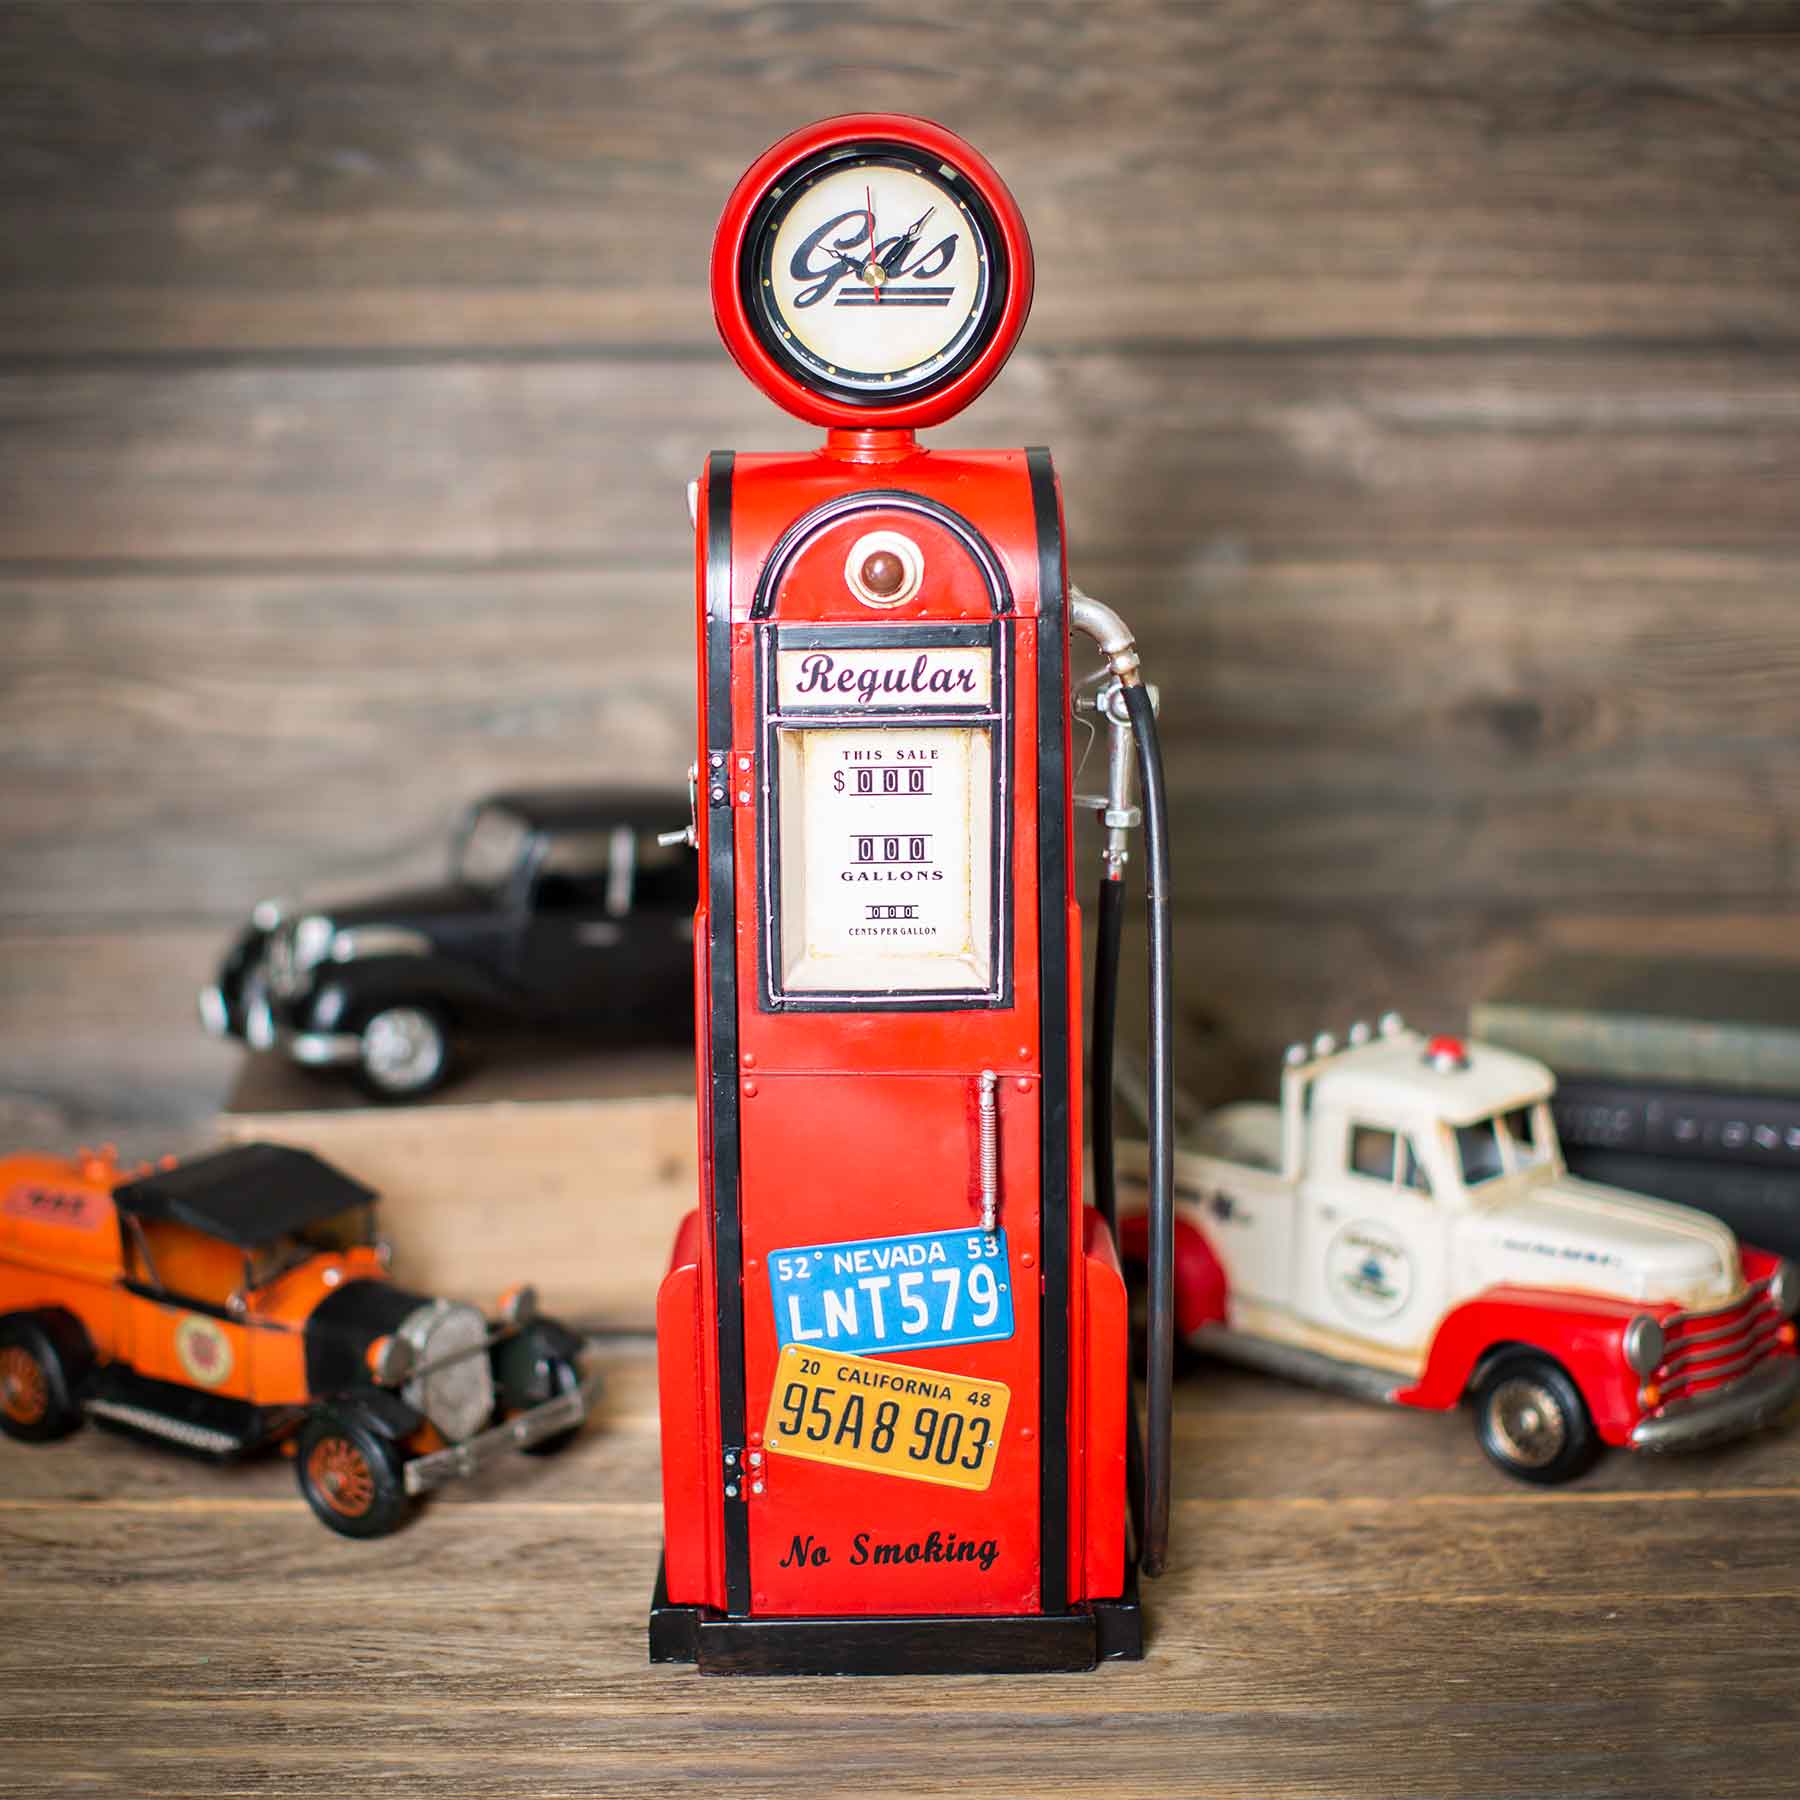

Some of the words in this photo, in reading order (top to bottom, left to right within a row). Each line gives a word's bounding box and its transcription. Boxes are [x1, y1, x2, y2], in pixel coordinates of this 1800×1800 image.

[790, 209, 959, 309] Gas
[796, 654, 976, 704] Regular
[843, 750, 883, 760] THIS
[896, 750, 939, 760] SALE
[841, 870, 944, 881] GALLONS
[900, 927, 937, 935] GALLON
[778, 1257, 811, 1281] 52
[833, 1241, 946, 1275] NEVADA
[967, 1237, 999, 1259] 53
[788, 1263, 999, 1341] LNT579
[800, 1359, 821, 1375] 20
[837, 1367, 952, 1400] CALIFORNIA
[967, 1391, 992, 1407] 48
[778, 1383, 900, 1453] 95A8
[908, 1408, 992, 1469] 903
[779, 1535, 831, 1568] No
[849, 1531, 1000, 1572] Smoking
